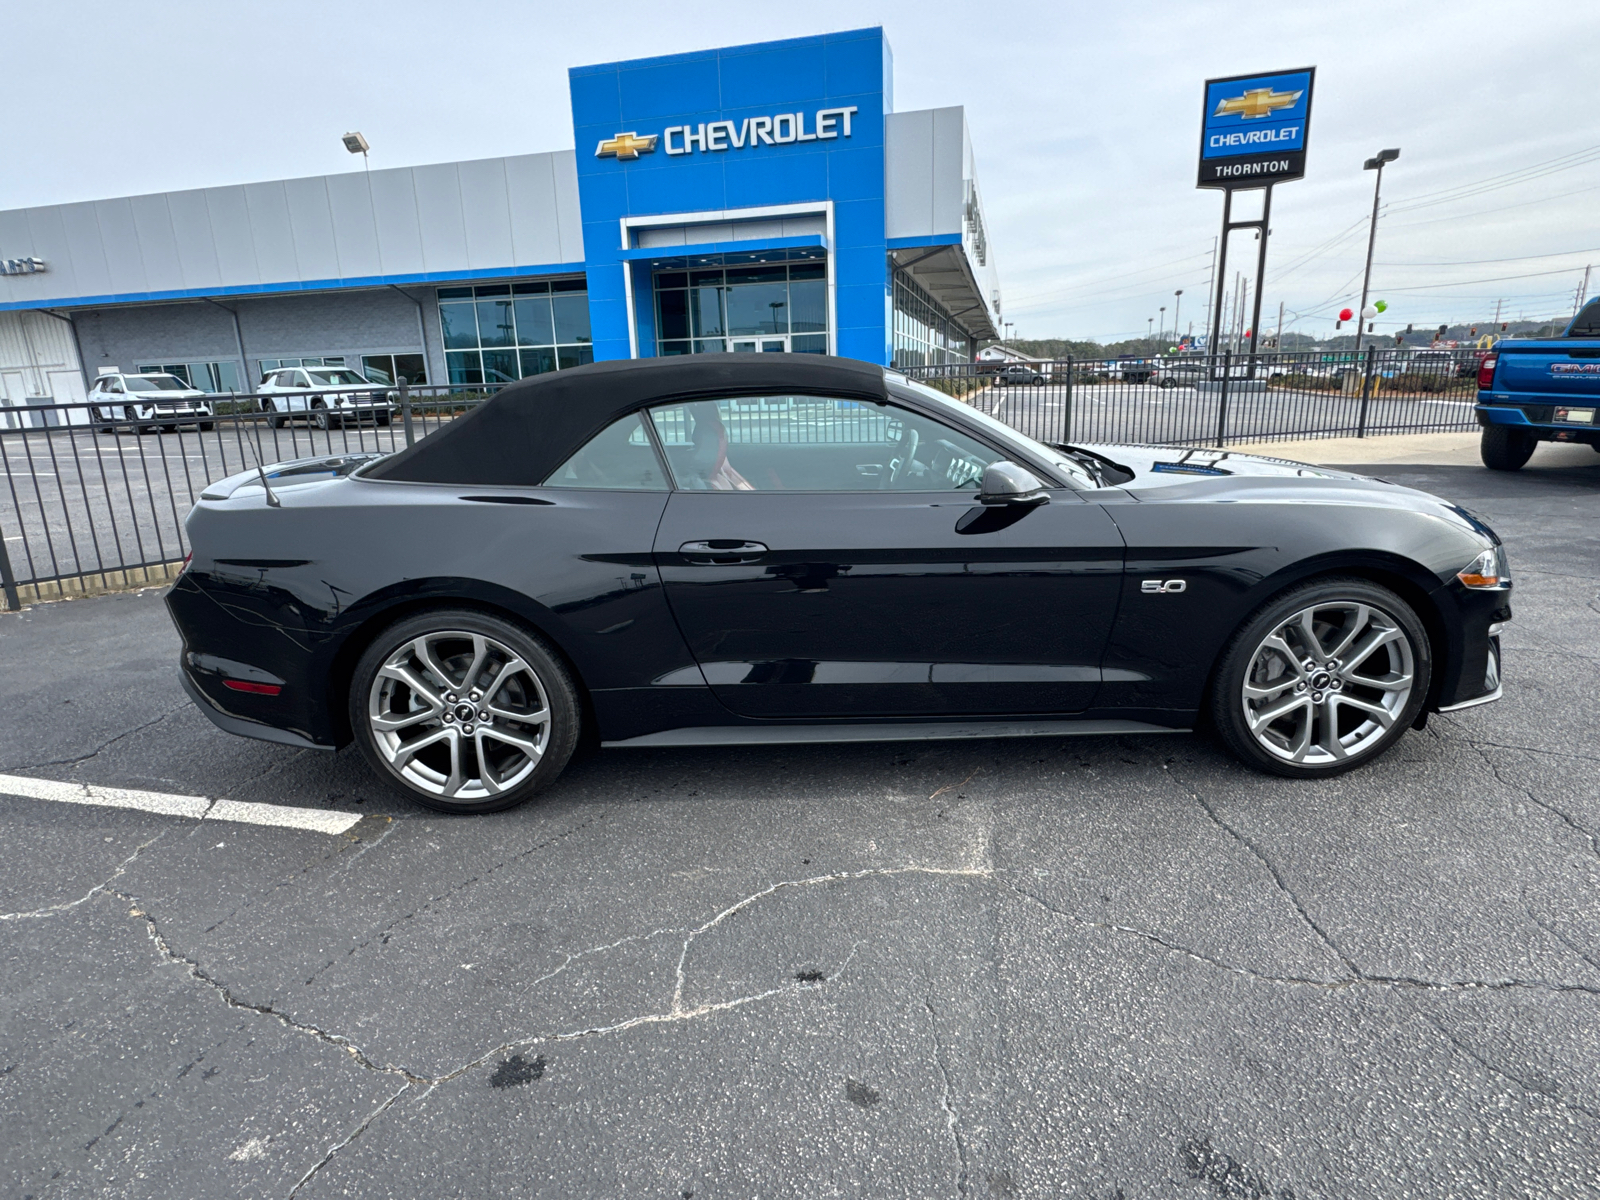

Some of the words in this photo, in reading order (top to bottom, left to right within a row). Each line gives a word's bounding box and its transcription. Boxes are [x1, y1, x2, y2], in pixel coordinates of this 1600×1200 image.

[664, 106, 858, 155] CHEVROLET
[1210, 127, 1299, 147] CHEVROLET
[1215, 160, 1289, 176] THORNTON
[1140, 579, 1187, 593] 5.0
